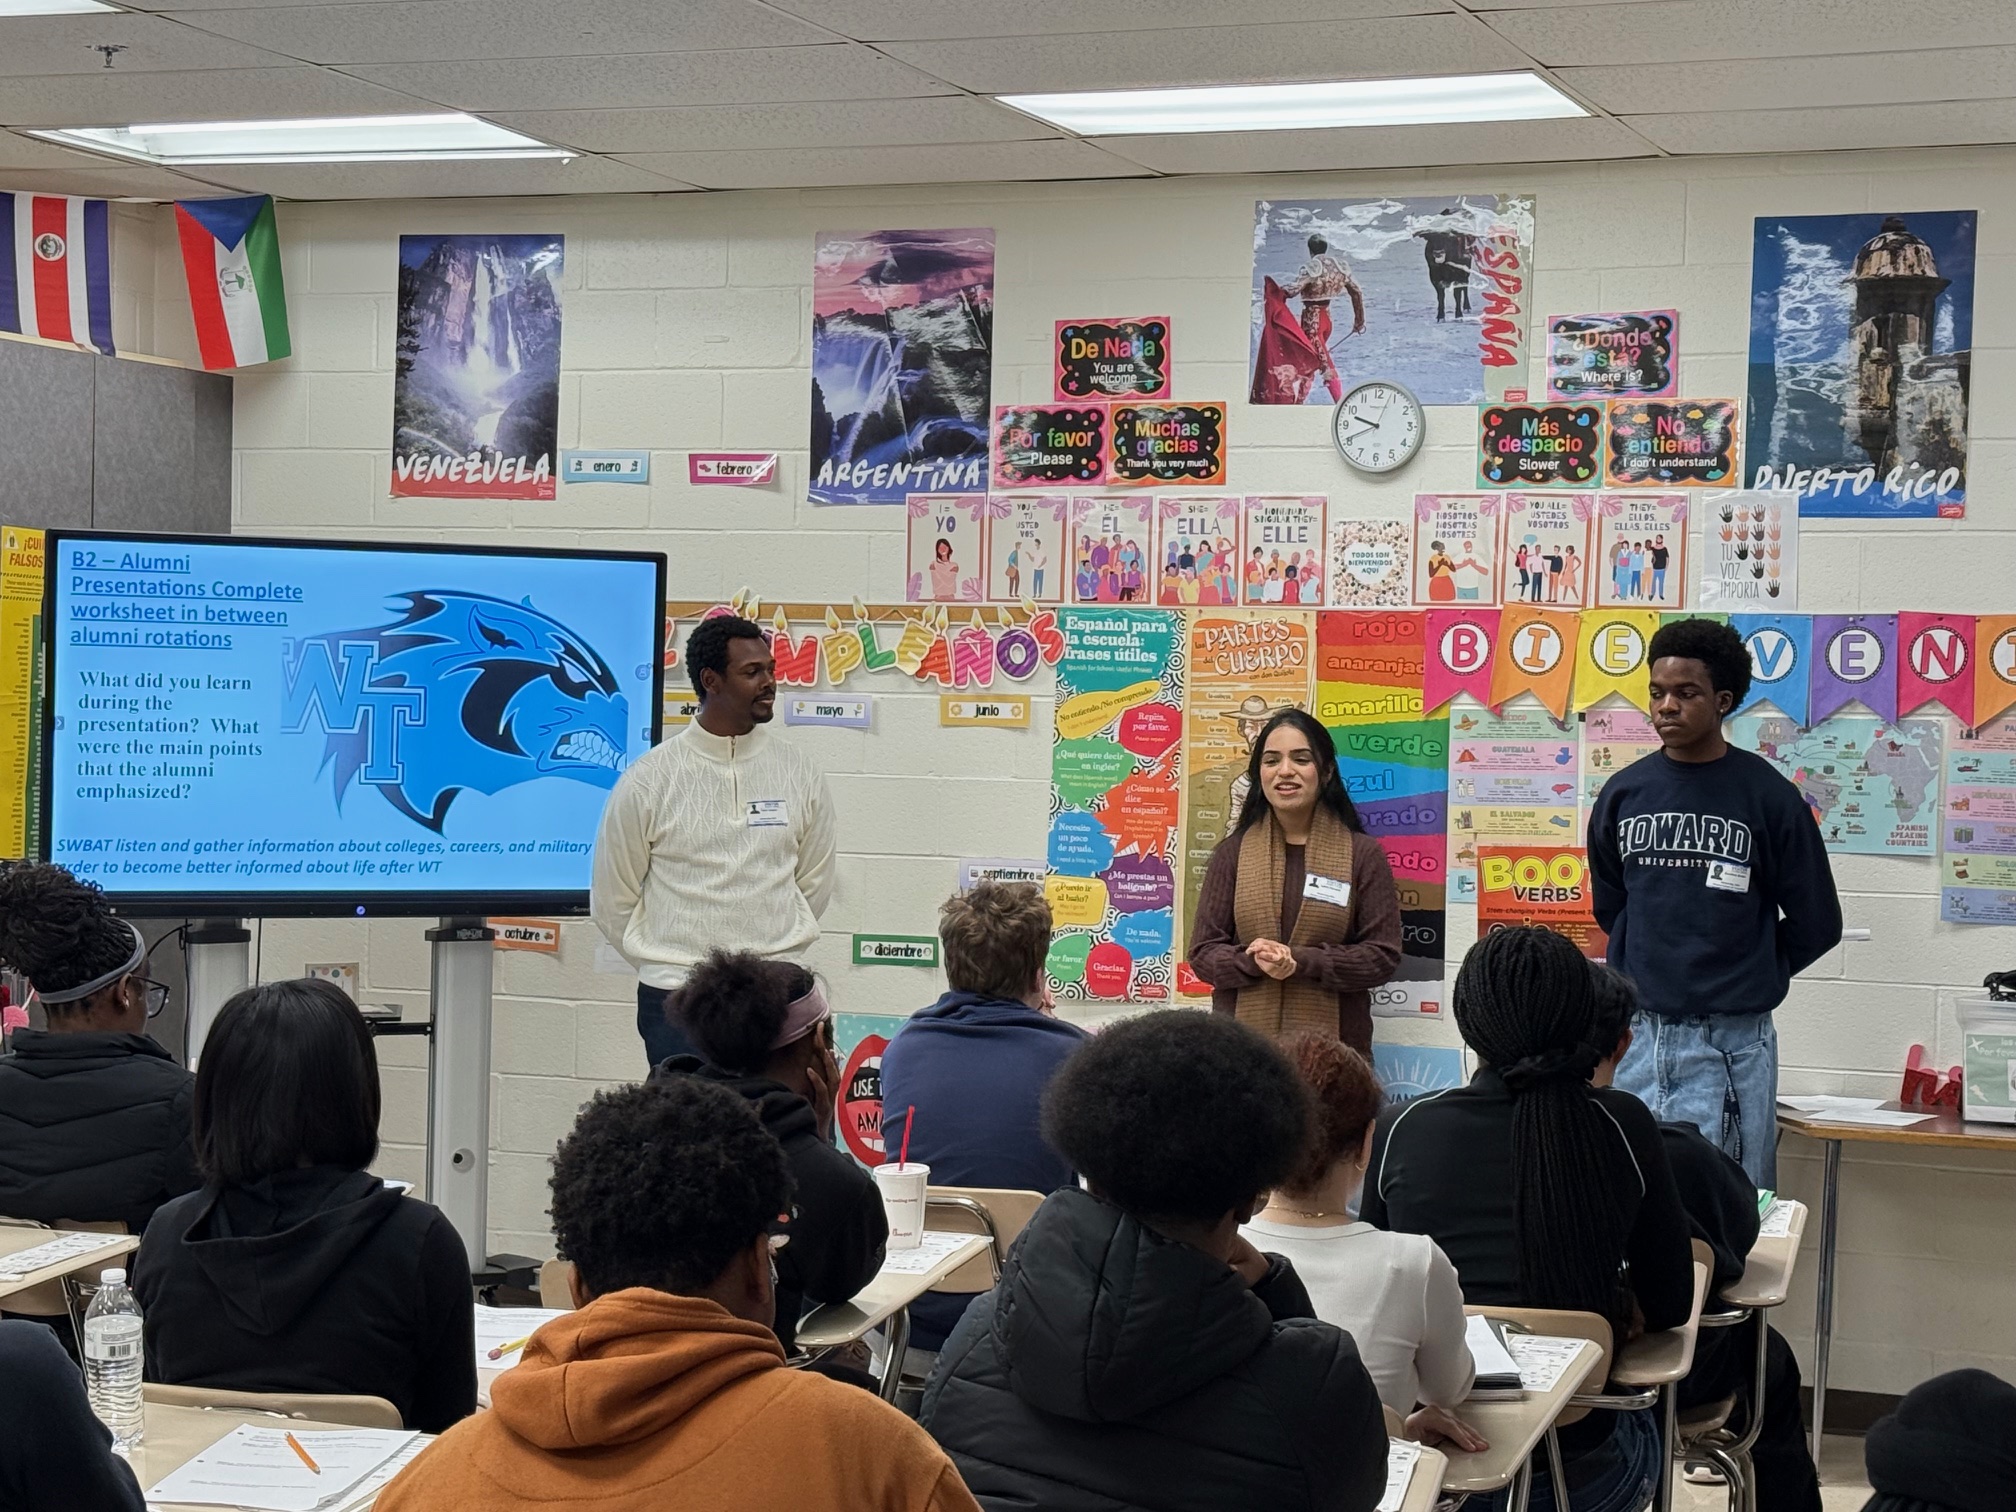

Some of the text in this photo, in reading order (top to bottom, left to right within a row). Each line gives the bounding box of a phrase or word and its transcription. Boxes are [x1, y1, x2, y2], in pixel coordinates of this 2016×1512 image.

[1478, 225, 1523, 367] ESPAÑA
[1071, 337, 1156, 359] De Nada
[1093, 362, 1134, 373] You are
[1090, 373, 1138, 384] welcome
[1581, 370, 1643, 383] Where is?
[1361, 393, 1367, 403] 11
[1375, 389, 1384, 399] 12
[1348, 405, 1358, 415] 10
[1402, 406, 1409, 415] 2
[1135, 420, 1200, 437] Muchas
[1342, 420, 1349, 430] 9
[1406, 422, 1413, 431] 3
[1521, 416, 1559, 436] Más
[1657, 416, 1686, 436] No
[1009, 428, 1095, 448] Por favor
[1346, 436, 1353, 446] 8
[1400, 438, 1407, 447] 4
[1498, 434, 1583, 456] despacio
[1628, 436, 1713, 456] entiendo
[1137, 437, 1198, 457] gracias
[1358, 448, 1364, 457] 7
[1388, 449, 1395, 459] 5
[1030, 452, 1073, 465] Please
[1126, 459, 1208, 469] Thank you very much
[1373, 453, 1379, 462] 6
[1519, 458, 1560, 470] Slower
[1630, 457, 1717, 467] don't understand
[395, 451, 551, 484] VENEZUELA
[593, 463, 621, 472] enero
[716, 461, 753, 475] febrero
[818, 459, 980, 491] ARGENTINA
[1753, 462, 1960, 501] PUERTO RICO
[1530, 501, 1544, 510] YOU
[1102, 513, 1123, 533] ÉL
[1436, 512, 1478, 520] NOSOTROS
[1531, 511, 1567, 520] USTEDES
[1628, 513, 1657, 522] ELLOS,
[936, 516, 956, 533] YO
[1016, 521, 1039, 529] USTED
[1177, 517, 1222, 535] ELLA
[1436, 521, 1478, 529] NOSOTRAS
[1527, 520, 1569, 529] VOSOTROS
[1614, 523, 1670, 531] ELLAS, ELLES
[1020, 530, 1034, 538] VOS
[1263, 526, 1308, 543] ELLE
[1435, 531, 1476, 539] NOSOTRES
[1722, 543, 1733, 561] TU
[9, 553, 44, 568] FALSOS
[72, 551, 190, 571] B2 Alumni
[1720, 562, 1741, 580] VOZ
[72, 576, 303, 601] Presentations Complete
[1720, 581, 1760, 599] IMPORTA
[71, 602, 288, 624] worksheet in between
[1065, 616, 1168, 634] Español para
[1353, 617, 1416, 642] rojo
[70, 626, 232, 647] alumni rotations
[1065, 631, 1145, 647] la escuela:
[1205, 617, 1291, 652] PARTES
[702, 604, 1064, 688] MPLEAÑOS
[1064, 646, 1158, 662] frases útiles
[1215, 642, 1305, 676] CUERPO
[79, 671, 252, 693] What did you learn
[78, 694, 173, 714] during the
[280, 637, 427, 785] WT
[815, 704, 845, 717] mayo
[973, 703, 1000, 718] junio
[1322, 694, 1424, 717] amarillo
[78, 717, 259, 735] presentation? What
[77, 739, 262, 760] were the main points
[1348, 733, 1442, 757] verde
[1056, 750, 1124, 760] ¿Qué quiere decir
[77, 760, 214, 777] that the alumni
[1341, 768, 1394, 793] zul
[76, 783, 191, 802] emphasized?
[1896, 824, 1929, 832] SPANISH
[1617, 813, 1752, 863] HOWARD
[1885, 839, 1929, 847] COUNTRIES
[57, 838, 592, 856] SWBAT listen and gather information about colleges, careers, and military
[103, 862, 118, 874] to
[123, 861, 182, 874] become
[186, 861, 231, 874] better
[235, 860, 301, 876] informed
[306, 861, 349, 873] about
[353, 860, 375, 876] life
[379, 860, 415, 876] after
[418, 861, 443, 873] WT
[1638, 857, 1711, 868] UNIVERSITY
[983, 868, 1035, 881] septiembre
[1127, 873, 1155, 881] prestas
[1480, 853, 1594, 893] BOO
[1513, 886, 1583, 904] VERBS
[505, 928, 540, 941] octubre
[1126, 928, 1137, 936] De
[874, 943, 923, 958] diciembre
[1093, 963, 1126, 973] Gracias.
[853, 1077, 875, 1097] USE
